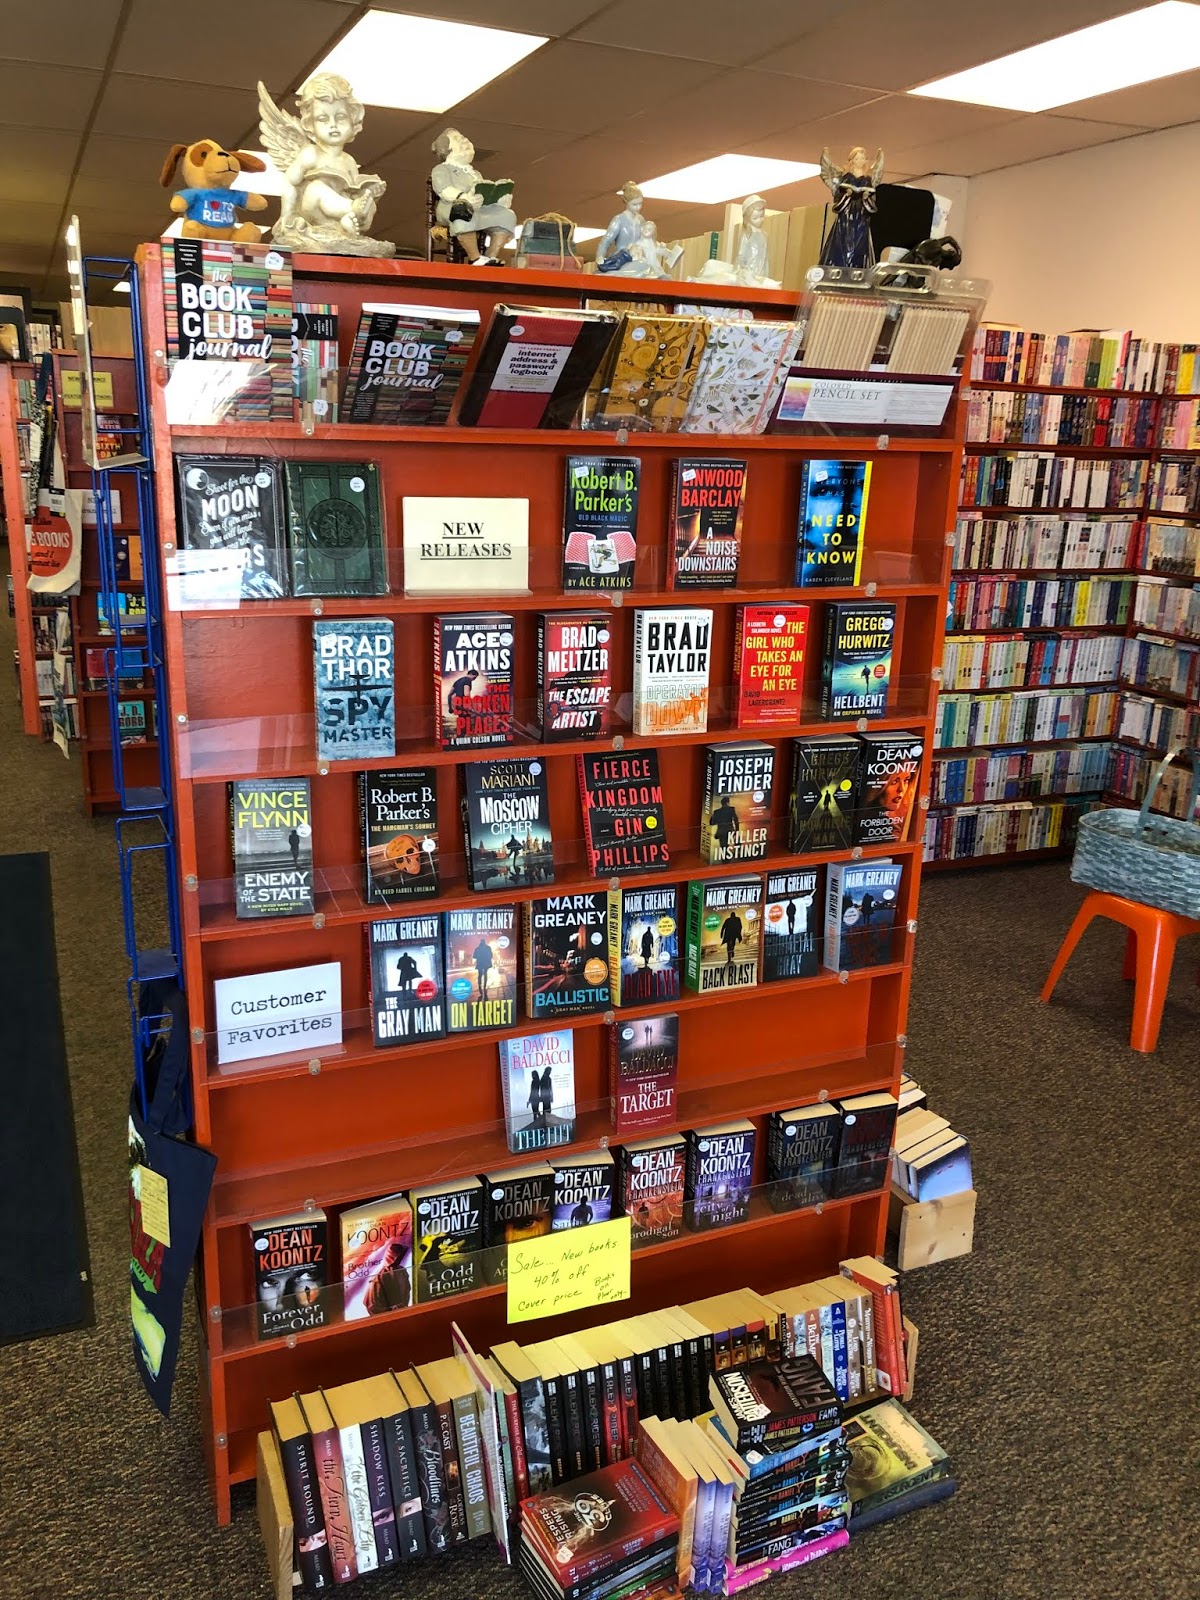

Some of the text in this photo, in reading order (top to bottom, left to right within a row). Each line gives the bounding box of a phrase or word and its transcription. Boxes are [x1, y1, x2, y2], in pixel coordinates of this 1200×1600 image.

[181, 283, 253, 312] BOOK
[182, 312, 254, 338] CLUB
[185, 333, 273, 360] journal
[369, 340, 437, 360] BOOK
[518, 350, 556, 359] internet
[365, 358, 429, 377] CLUB
[509, 362, 555, 371] password
[511, 356, 549, 364] address
[360, 373, 443, 391] journal
[510, 368, 549, 377] logbook
[813, 389, 881, 400] PENCIL SET
[624, 471, 638, 491] B.
[201, 485, 259, 521] MOON
[575, 490, 632, 512] Parker's
[681, 489, 741, 508] BARCLAY
[578, 514, 589, 522] OLD
[811, 515, 856, 527] NEED
[442, 522, 484, 537] NEW
[706, 527, 713, 539] A
[823, 532, 842, 545] TO
[36, 532, 70, 548] BOOKS
[706, 541, 737, 556] NOISE
[420, 543, 512, 558] RELEASES
[807, 551, 855, 564] KNOW
[678, 556, 736, 572] DOWNSTAIRS
[568, 577, 631, 588] BY ACE ATKINS
[562, 626, 597, 649] BRAD
[648, 622, 709, 651] BRAD
[786, 622, 805, 634] THE
[320, 634, 391, 657] BRAD
[456, 632, 500, 648] ACE
[746, 637, 794, 649] GIRL WHO
[838, 634, 890, 649] HURWITZ
[445, 649, 510, 671] ATKINS
[548, 650, 608, 673] MELTZER
[648, 653, 707, 673] TAYLOR
[757, 650, 803, 663] TAKES AN
[322, 658, 391, 681] THOR
[751, 665, 792, 677] EYE FOR
[486, 684, 509, 693] THE
[762, 678, 797, 691] AN EYE
[453, 694, 510, 715] BROKEN
[549, 687, 611, 705] THE ESCAPE
[834, 694, 884, 709] HELLBENT
[323, 695, 392, 727] SPY
[552, 711, 597, 729] ARTIST
[119, 716, 144, 727] ROBB
[456, 715, 510, 735] PLACES
[324, 726, 392, 743] MASTER
[877, 749, 913, 761] DEAN
[490, 764, 525, 774] SCOTT
[593, 760, 650, 779] FIERCE
[718, 757, 773, 776] JOSEPH
[867, 761, 918, 775] KOONTZ
[718, 774, 771, 793] FINDER
[238, 791, 307, 809] VINCE
[371, 786, 436, 805] Robert B.
[586, 786, 663, 809] KINGDOM
[239, 810, 308, 829] FLYNN
[376, 804, 430, 821] Parker's
[860, 816, 903, 828] FORBIDDEN
[381, 823, 414, 831] HANGMAN'S
[415, 822, 436, 830] SONNET
[491, 822, 532, 835] CIPHER
[614, 818, 643, 837] GIN
[868, 826, 892, 836] DOOR
[727, 828, 767, 846] KILLER
[593, 843, 669, 868] PHILLIPS
[714, 843, 766, 861] INSTINCT
[245, 872, 309, 887] ENEMY
[240, 887, 311, 903] THE STATE
[547, 895, 595, 911] MARK
[624, 892, 676, 913] MARK GREANEY
[706, 886, 762, 907] MARK GREANEY
[450, 913, 514, 931] MARK GREANEY
[534, 911, 606, 928] GREANEY
[373, 919, 438, 942] MARK GREANEY
[702, 963, 755, 989] BACK BLAST
[231, 989, 327, 1015] Customer
[385, 997, 398, 1009] THE
[535, 987, 609, 1007] BALLISTIC
[378, 1005, 441, 1038] GRAY MAN
[451, 1000, 513, 1028] ON TARGET
[227, 1016, 332, 1046] Favorites
[522, 1037, 559, 1054] DAVID
[512, 1050, 571, 1070] BALDACCI
[638, 1082, 657, 1092] THE
[620, 1089, 674, 1114] TARGET
[516, 1124, 572, 1150] THE HIT
[709, 1137, 745, 1157] DEAN
[640, 1150, 675, 1173] DEAN
[701, 1152, 751, 1174] KOONTZ
[564, 1170, 603, 1188] DEAN
[631, 1165, 682, 1191] KOONTZ
[698, 1169, 751, 1184] FRANKENSTEIN
[554, 1185, 611, 1206] KOONTZ
[430, 1195, 470, 1218] DEAN
[421, 1210, 479, 1237] KOONTZ
[268, 1228, 313, 1251] DEAN
[259, 1244, 323, 1272] KOONTZ
[561, 1249, 583, 1261] New
[588, 1239, 618, 1254] books
[348, 1258, 382, 1272] Brother
[348, 1268, 370, 1279] Odd
[441, 1262, 474, 1280] Odd
[429, 1275, 474, 1294] Hours
[534, 1264, 590, 1288] 40% off
[518, 1290, 583, 1312] Cover price
[263, 1303, 320, 1324] Forever
[290, 1312, 324, 1329] Odd
[781, 1358, 836, 1409] FANG
[728, 1397, 744, 1421] JAMES
[768, 1407, 838, 1432] JAMES PATTERSON FANG
[369, 1424, 387, 1498] SHADOW KISS
[394, 1418, 412, 1499] LAST SACRIFICE
[458, 1412, 485, 1505] BEAUTIFUL CHAOS
[297, 1444, 315, 1525] SPIRIT BOUND
[424, 1449, 441, 1504] Bloodlines
[539, 1507, 567, 1546] VESPERS
[550, 1510, 573, 1540] RISING
[768, 1538, 792, 1555] FANG
